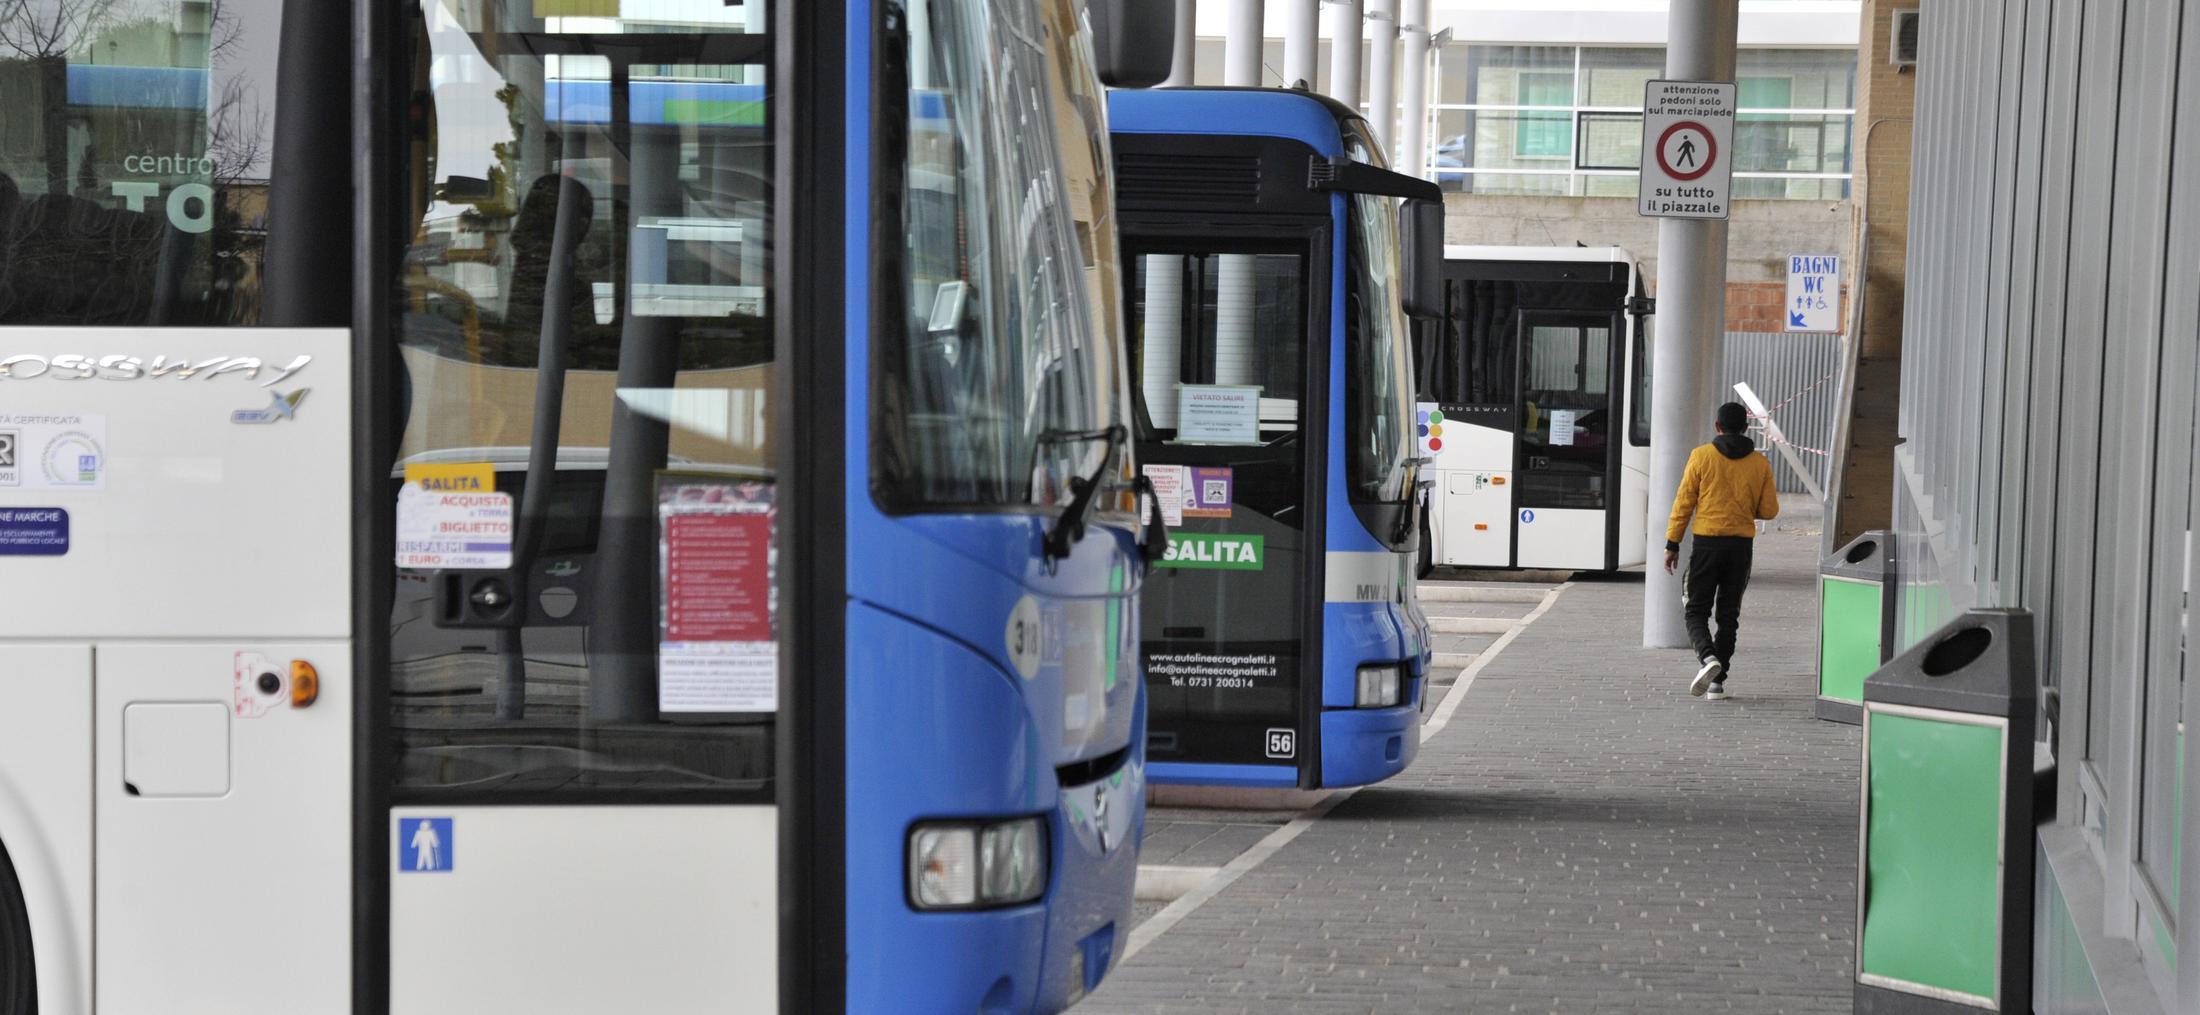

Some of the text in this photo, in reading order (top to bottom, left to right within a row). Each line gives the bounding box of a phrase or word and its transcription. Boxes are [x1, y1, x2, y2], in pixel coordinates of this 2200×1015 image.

[1663, 86, 1720, 95] attenzione
[1660, 96, 1721, 106] pedoni solo
[1648, 107, 1732, 117] sul marciapiede
[124, 152, 213, 175] centro
[1655, 186, 1714, 198] su tutto
[1647, 200, 1721, 213] il piazzale
[1791, 256, 1837, 274] BAGNI
[1804, 276, 1825, 294] WC
[0, 354, 313, 388] OSSWAY
[1441, 405, 1508, 413] CROSSWAY
[14, 416, 81, 424] CERTIFICATA
[421, 477, 480, 491] SALITA
[440, 496, 509, 507] ACQUISTA
[15, 512, 60, 522] MARCHE
[440, 522, 509, 534] BIGLIETTO
[1163, 540, 1257, 562] SALITA
[408, 555, 441, 565] EURO
[1356, 584, 1380, 600] MW
[1149, 653, 1276, 666] www.autolineecrognaletti.it
[1148, 664, 1277, 678] info@autolineecrognaletti.it
[1170, 677, 1254, 688] Tel. 0731 200314
[1270, 735, 1292, 753] 56
